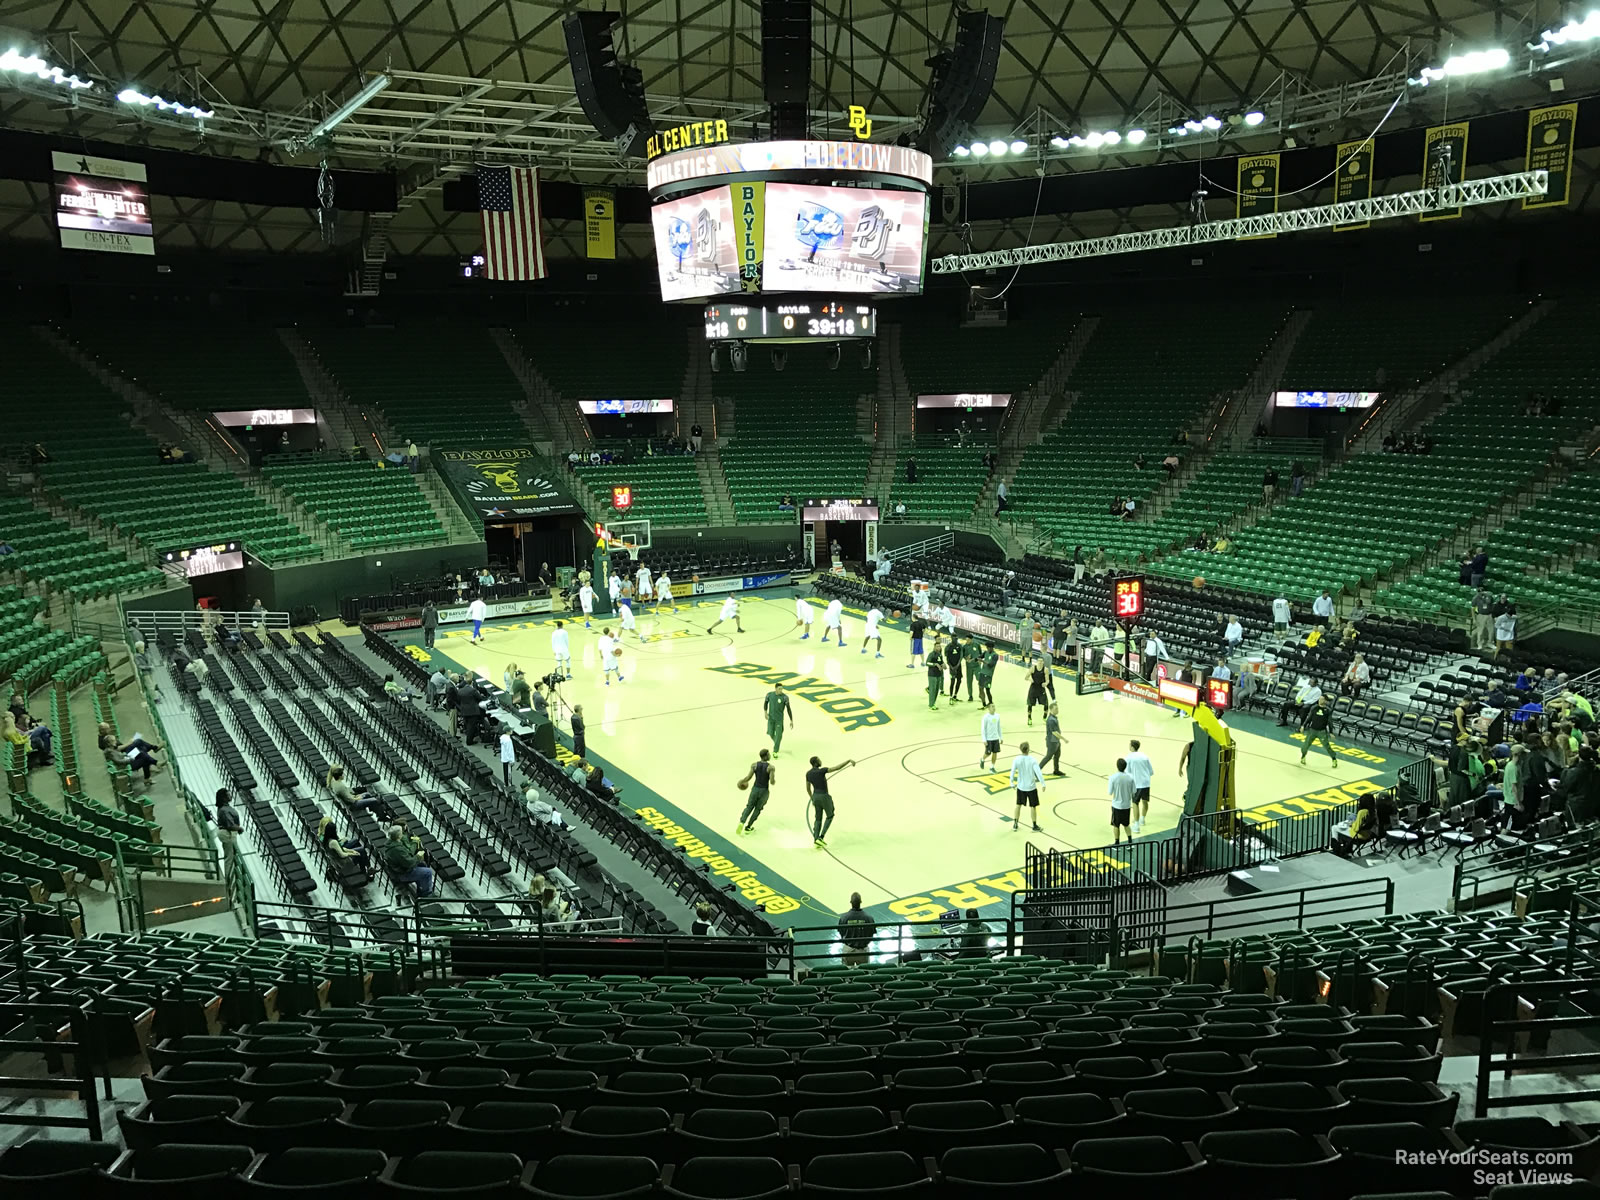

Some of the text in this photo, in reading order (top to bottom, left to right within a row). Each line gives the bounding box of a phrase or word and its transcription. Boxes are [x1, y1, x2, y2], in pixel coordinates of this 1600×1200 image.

[848, 105, 872, 139] BU
[1533, 109, 1573, 127] BAYLOR
[663, 119, 729, 152] CENTER
[1429, 127, 1465, 144] BAYLOR
[1241, 159, 1277, 171] BAYLOR
[84, 231, 131, 246] CEN-TEX
[742, 186, 757, 278] BAYLOR
[778, 306, 811, 314] BAYLOR
[783, 315, 795, 330] 0
[808, 318, 855, 335] 39:18
[441, 448, 534, 461] BAYLOR
[616, 494, 629, 506] 30
[819, 512, 862, 520] BASKETBALL
[868, 525, 876, 556] BEARS
[1120, 593, 1138, 614] 30
[387, 614, 407, 622] Waco
[702, 661, 896, 733] BAYLOR
[1214, 690, 1226, 705] 30
[635, 806, 801, 915] @BaylorAthletics
